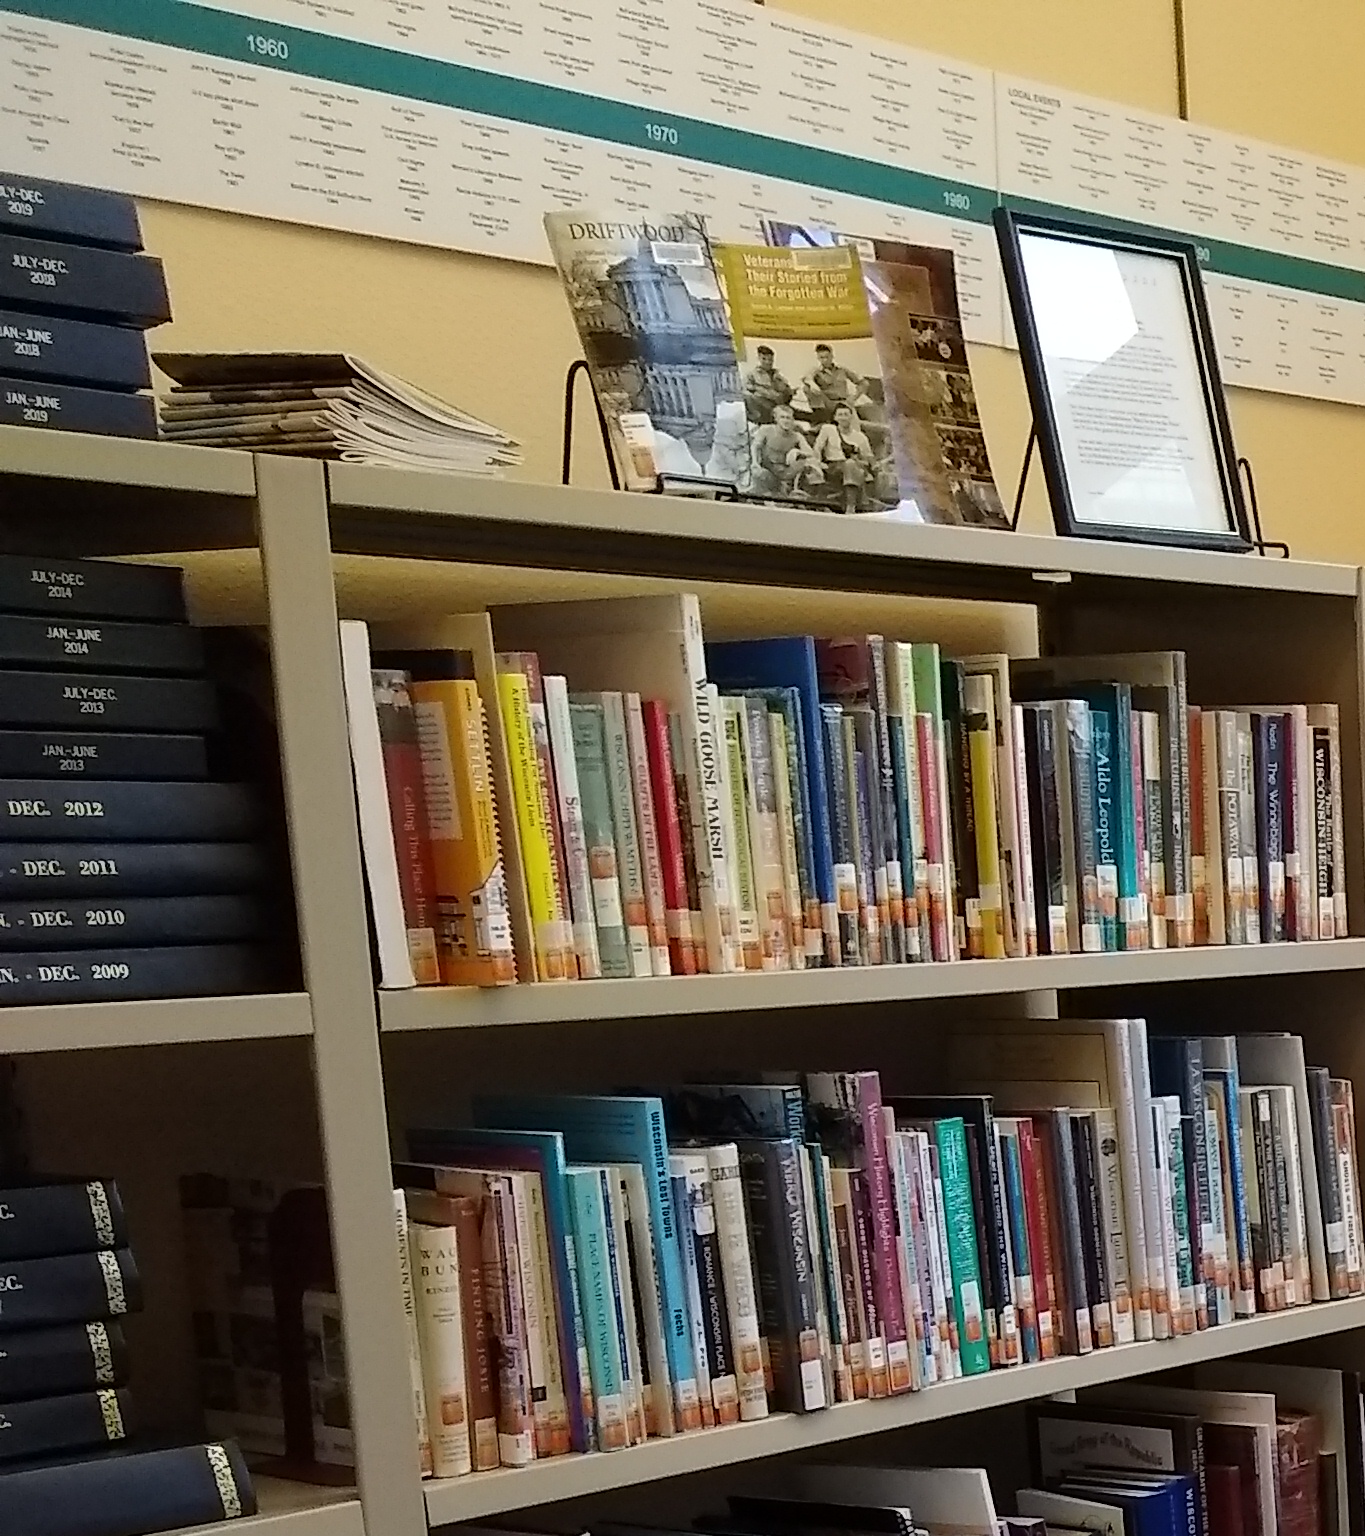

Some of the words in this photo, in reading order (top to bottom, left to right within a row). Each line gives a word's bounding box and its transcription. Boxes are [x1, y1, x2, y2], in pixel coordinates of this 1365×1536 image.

[246, 34, 289, 60] 1960
[645, 123, 678, 145] 1970
[7, 200, 34, 216] 2019
[568, 221, 685, 243] DRIFTWOOD
[12, 254, 69, 274] JULY-DEC.
[30, 271, 56, 287] 2018
[747, 268, 774, 283] Their
[777, 270, 817, 284] Stories
[820, 272, 848, 284] from
[748, 284, 767, 297] the
[769, 284, 825, 301] Forgotten
[827, 285, 850, 298] War
[14, 341, 40, 357] 2018
[5, 391, 61, 410] JAN.-JUNE
[23, 408, 48, 422] 2019
[48, 585, 73, 599] 2014
[46, 626, 102, 642] JAN.-JUNE
[64, 641, 89, 654] 2014
[63, 686, 118, 701] JULY-DEC.
[694, 677, 711, 725] WILD
[80, 701, 105, 714] 2013
[1269, 723, 1278, 749] Radin
[42, 745, 98, 759] JAN.-JUNE
[512, 697, 522, 731] History
[521, 755, 533, 806] Wisconsin
[699, 731, 717, 790] GOOSE
[59, 759, 85, 772] 2013
[1096, 750, 1110, 791] Aldo
[1268, 762, 1280, 785] The
[1315, 748, 1326, 839] WISCONSIN
[8, 800, 51, 817] DEC.
[64, 801, 105, 817] 2012
[705, 795, 725, 861] MARSH
[1096, 798, 1115, 864] Leopold
[22, 860, 66, 877] DEC.
[79, 860, 119, 876] 2011
[30, 911, 73, 928] DEC.
[85, 910, 125, 926] 2010
[38, 966, 81, 982] DEC.
[91, 964, 130, 979] 2009
[651, 1111, 666, 1176] Wisconsin's
[657, 1178, 669, 1199] Lost
[661, 1201, 674, 1239] Towns
